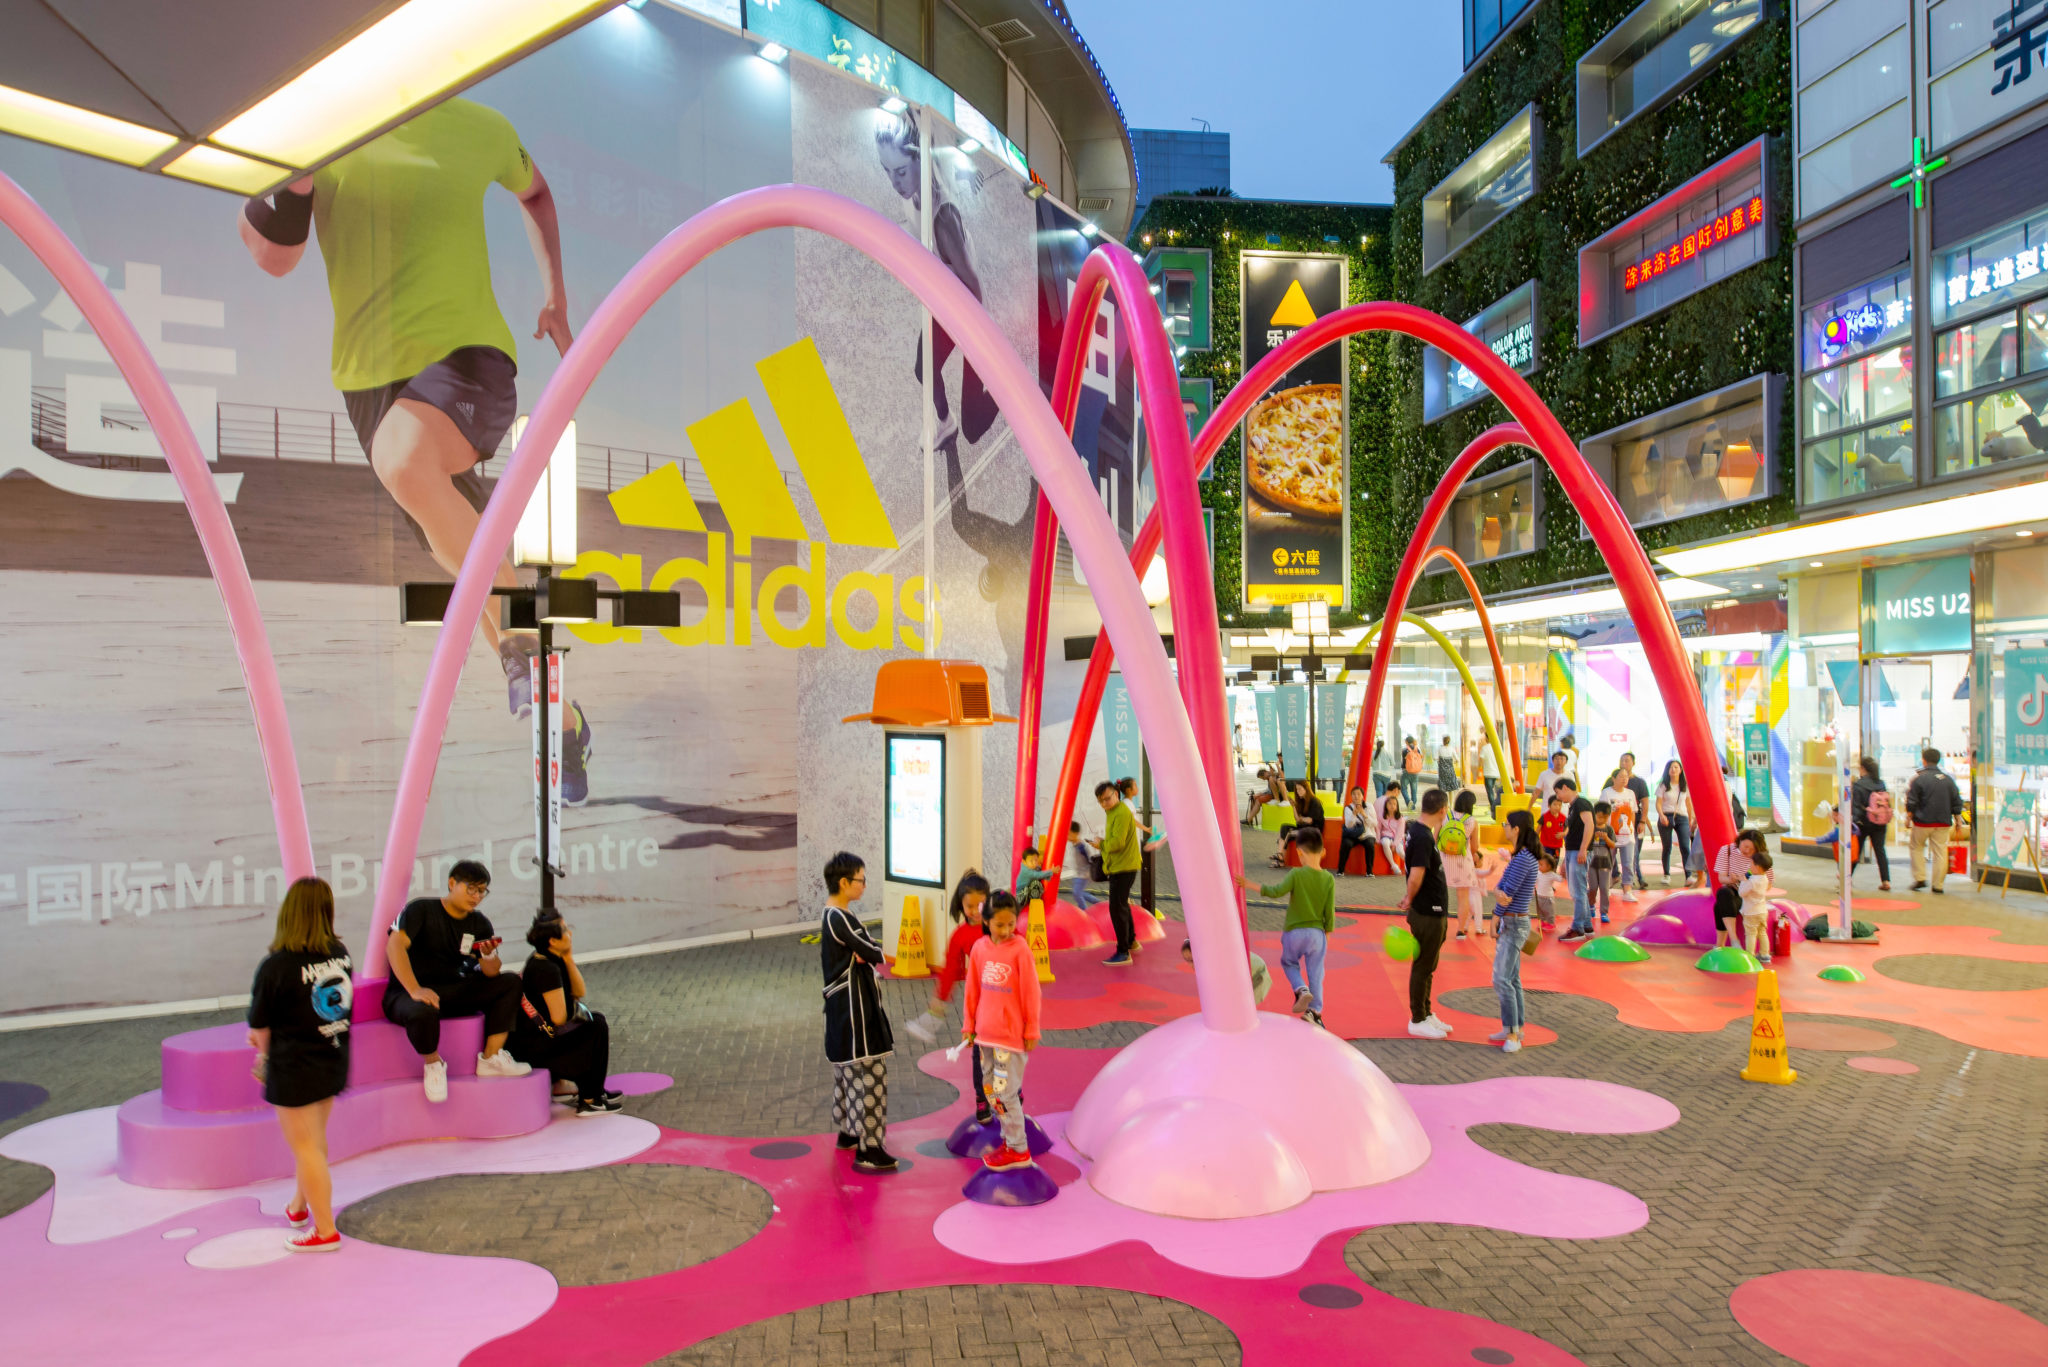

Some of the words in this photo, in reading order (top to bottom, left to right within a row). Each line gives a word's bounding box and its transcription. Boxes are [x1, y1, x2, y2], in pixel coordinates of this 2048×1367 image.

[1625, 197, 1763, 290] 涂来涂去国际创意美
[1492, 332, 1513, 356] COLOR
[1290, 549, 1321, 566] 六座
[559, 531, 943, 653] adidas
[1886, 597, 1935, 620] MISS
[1941, 592, 1970, 616] U2
[1115, 687, 1129, 735] MISS
[1287, 693, 1297, 726] MISS
[1325, 691, 1335, 725] MISS
[0, 862, 168, 926] 国际
[174, 855, 289, 909] Min
[510, 831, 660, 881] Cntre
